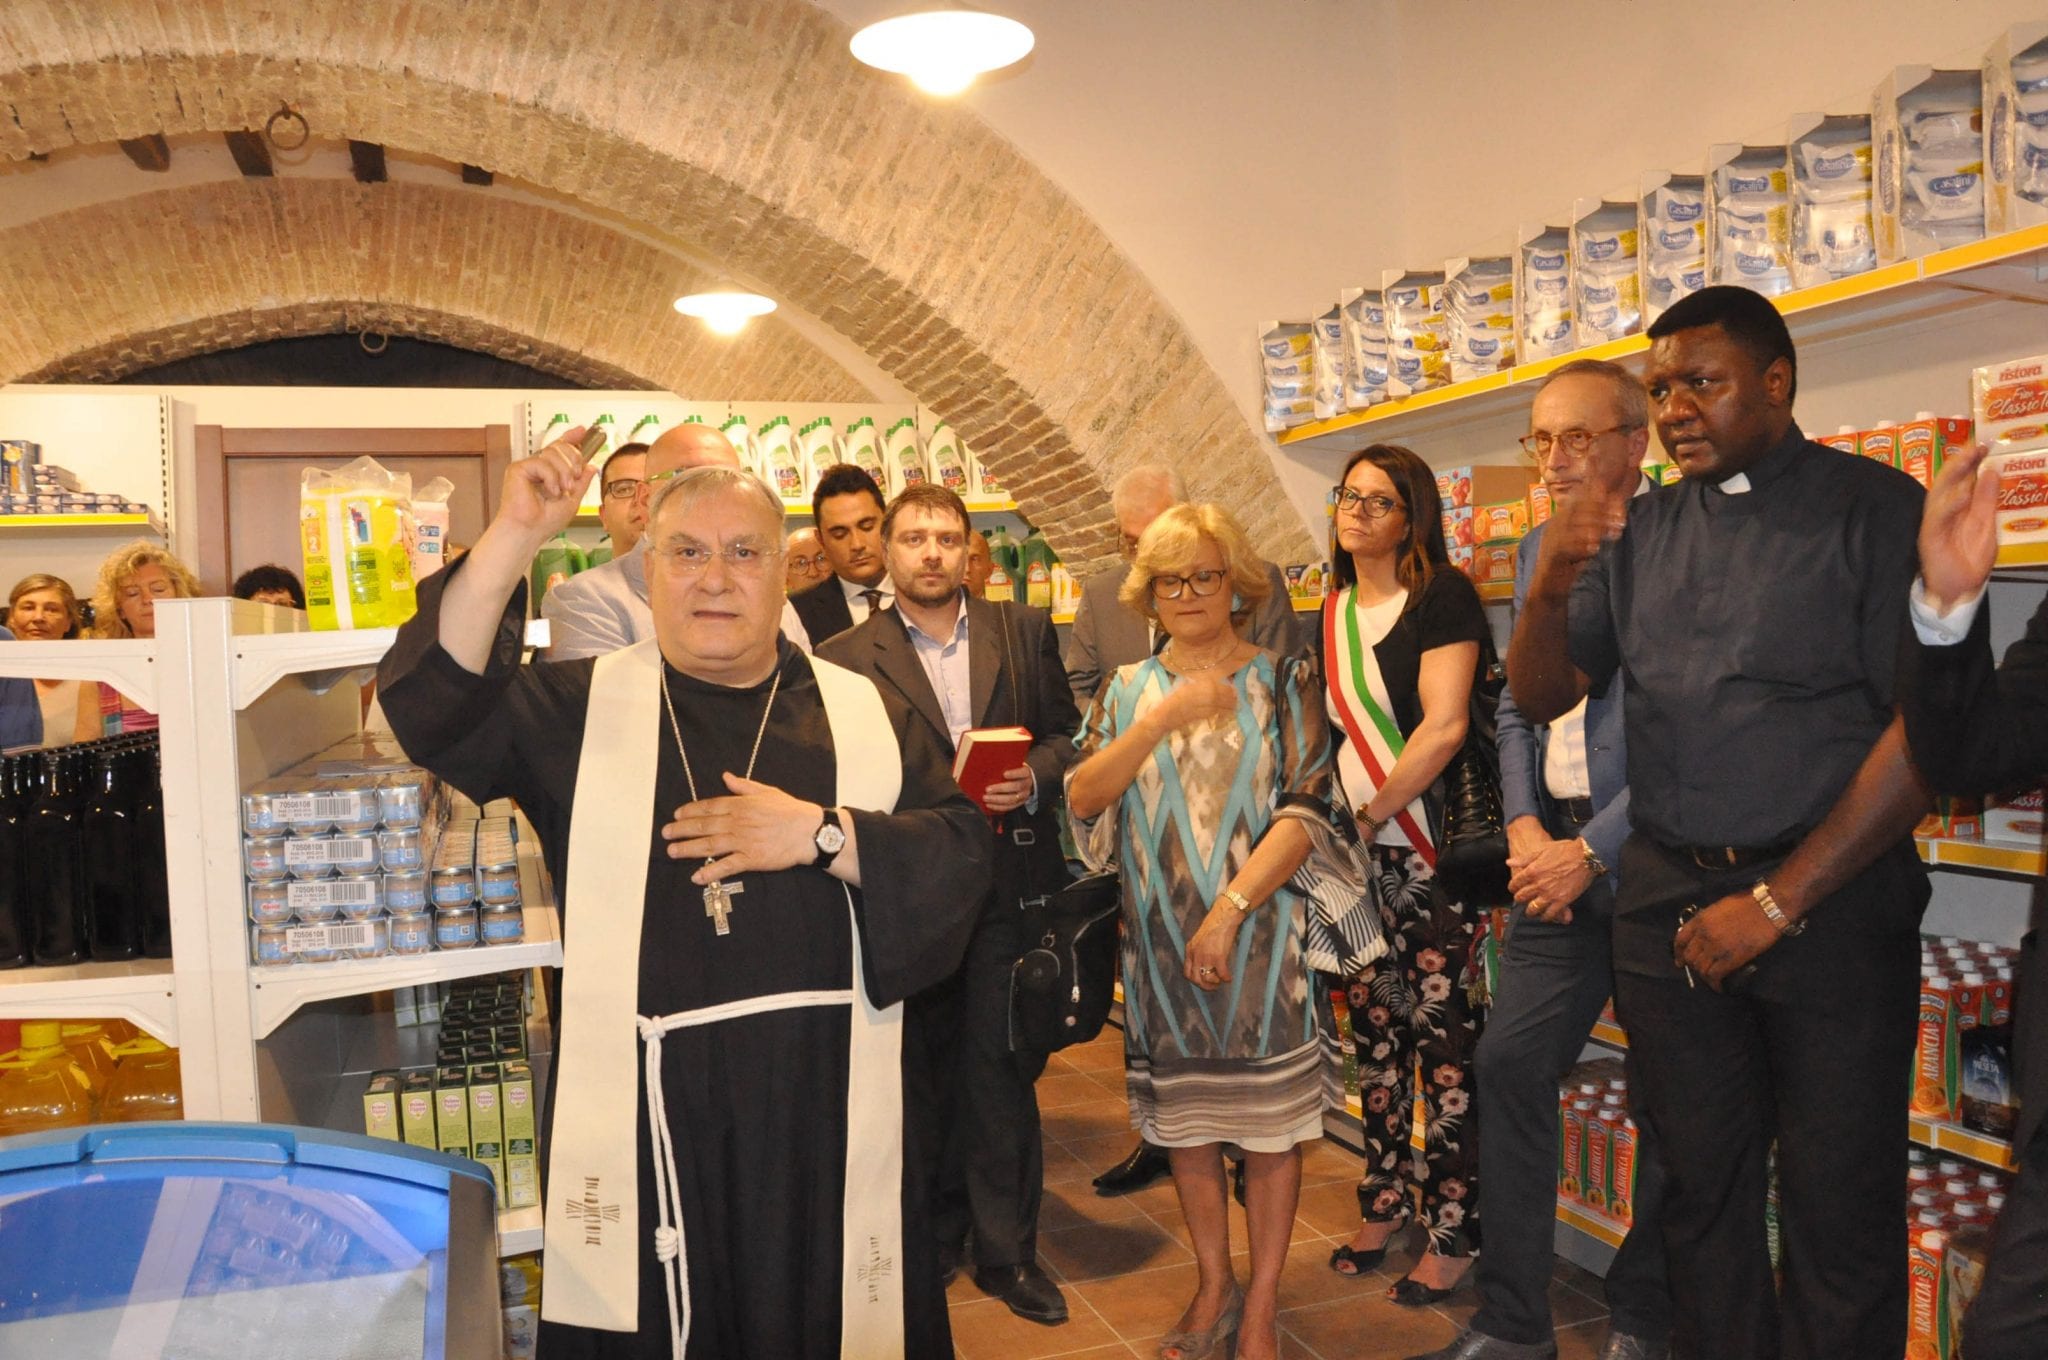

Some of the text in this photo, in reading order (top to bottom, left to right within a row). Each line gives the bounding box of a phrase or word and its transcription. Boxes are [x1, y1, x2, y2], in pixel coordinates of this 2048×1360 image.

[1933, 173, 1971, 190] Casalini
[2000, 365, 2042, 381] ristora
[1987, 398, 2039, 418] Classic
[2003, 458, 2046, 472] ristora
[1922, 1028, 1939, 1081] ARANCIA
[1915, 1281, 1932, 1336] ARANCIA
